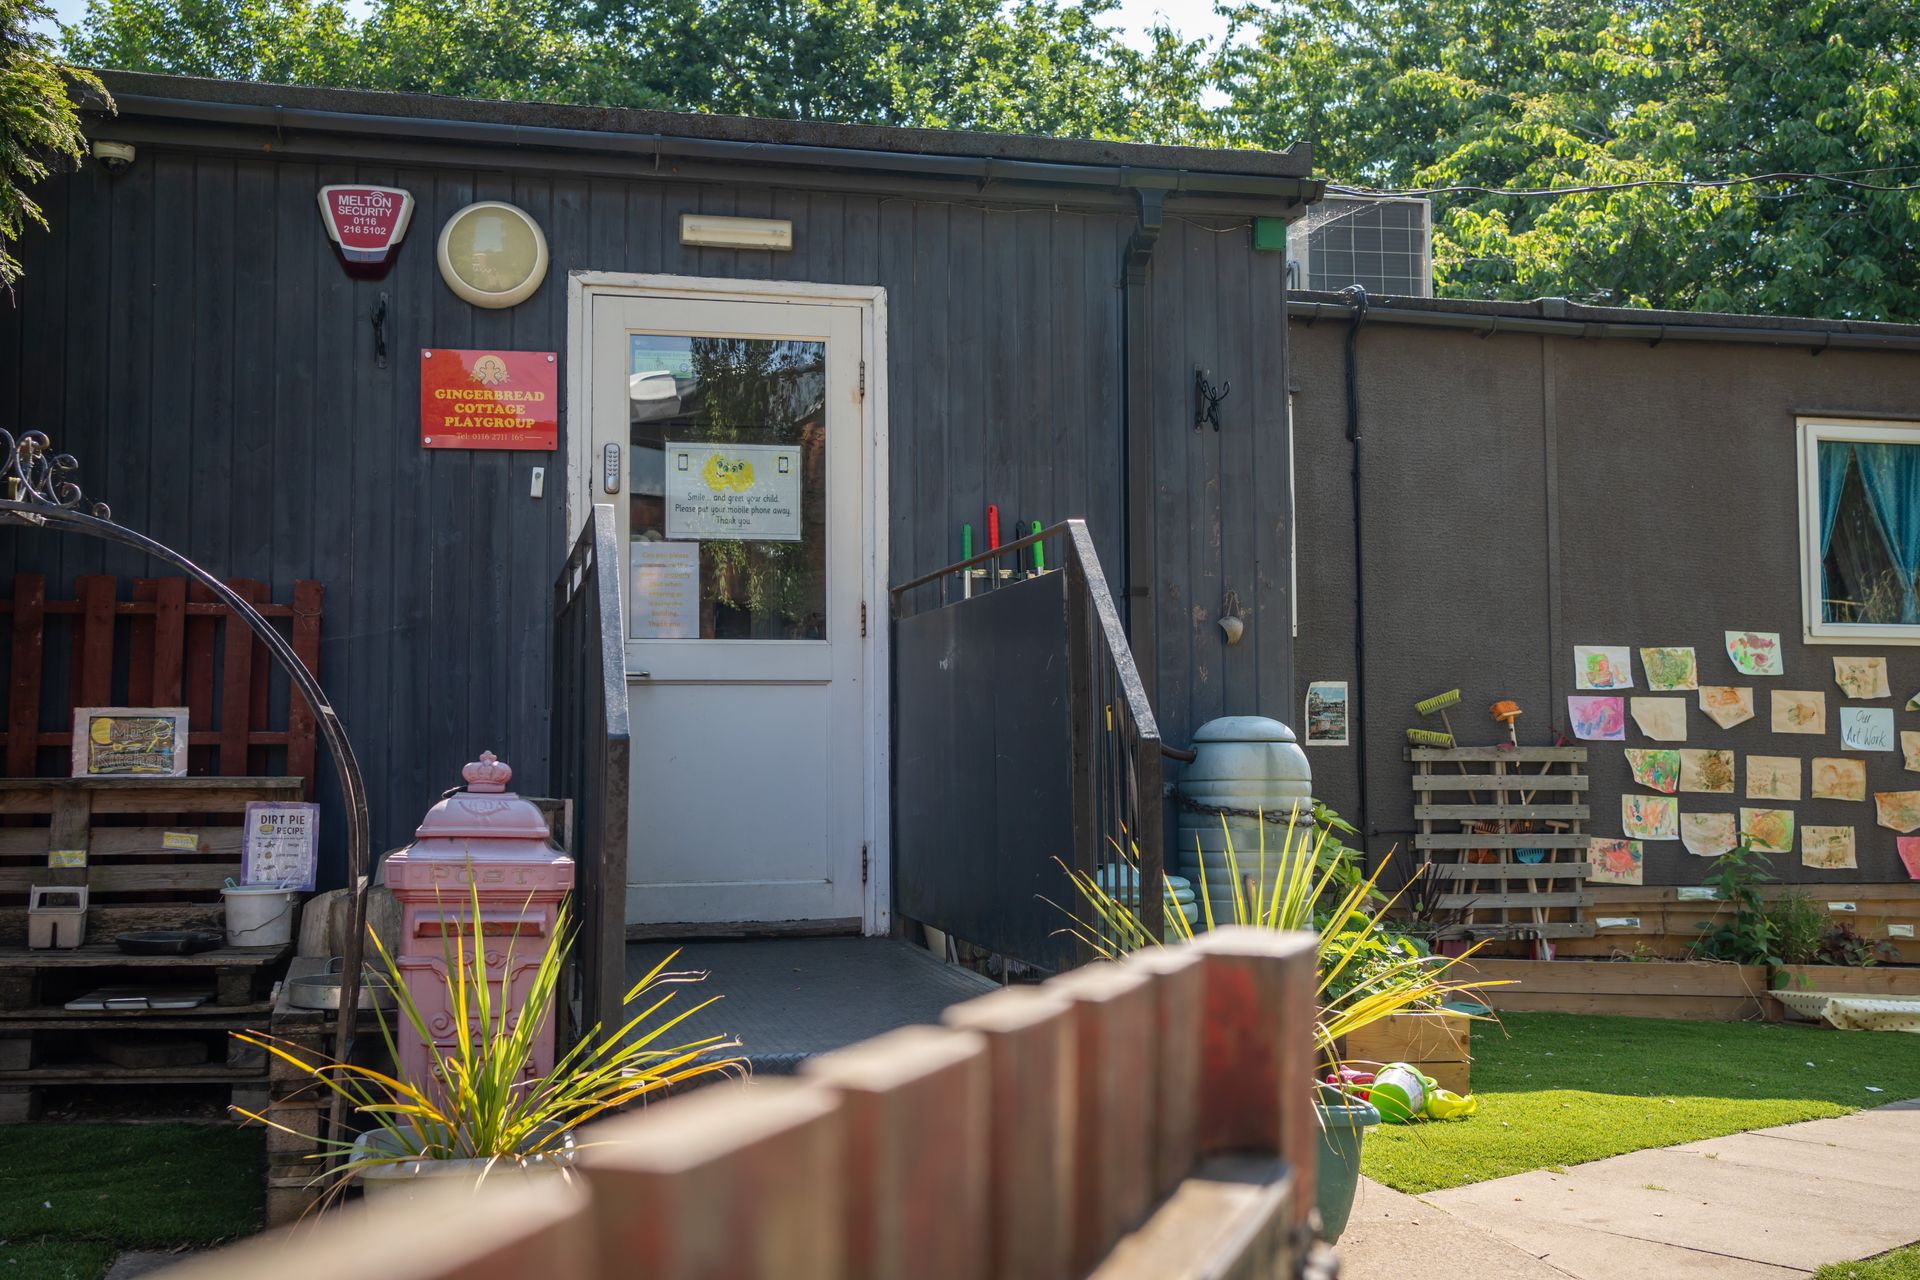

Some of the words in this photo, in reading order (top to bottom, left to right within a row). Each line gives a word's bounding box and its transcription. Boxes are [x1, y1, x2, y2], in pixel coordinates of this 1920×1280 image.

[338, 194, 392, 208] MELTON
[338, 206, 393, 217] SECURITY
[353, 216, 377, 225] 0116
[343, 225, 361, 234] 216
[362, 226, 387, 235] 5102
[434, 388, 545, 402] GINGERBREAD
[453, 402, 526, 415] COTTAGE
[443, 416, 536, 429] PLAYGROUP
[713, 492, 726, 502] and
[674, 503, 696, 513] Please
[697, 505, 709, 515] put
[710, 506, 726, 516] your
[727, 505, 750, 514] mobile
[750, 505, 771, 516] phone
[715, 515, 736, 525] Thank
[1855, 709, 1873, 724] Our
[110, 720, 156, 741] Mud
[1846, 725, 1862, 745] Art
[1864, 725, 1888, 748] Work
[95, 749, 169, 768] Kitchen
[260, 814, 285, 825] DIRT
[289, 814, 306, 825] PIE
[276, 826, 305, 836] RECIPE
[429, 866, 532, 884] POST
